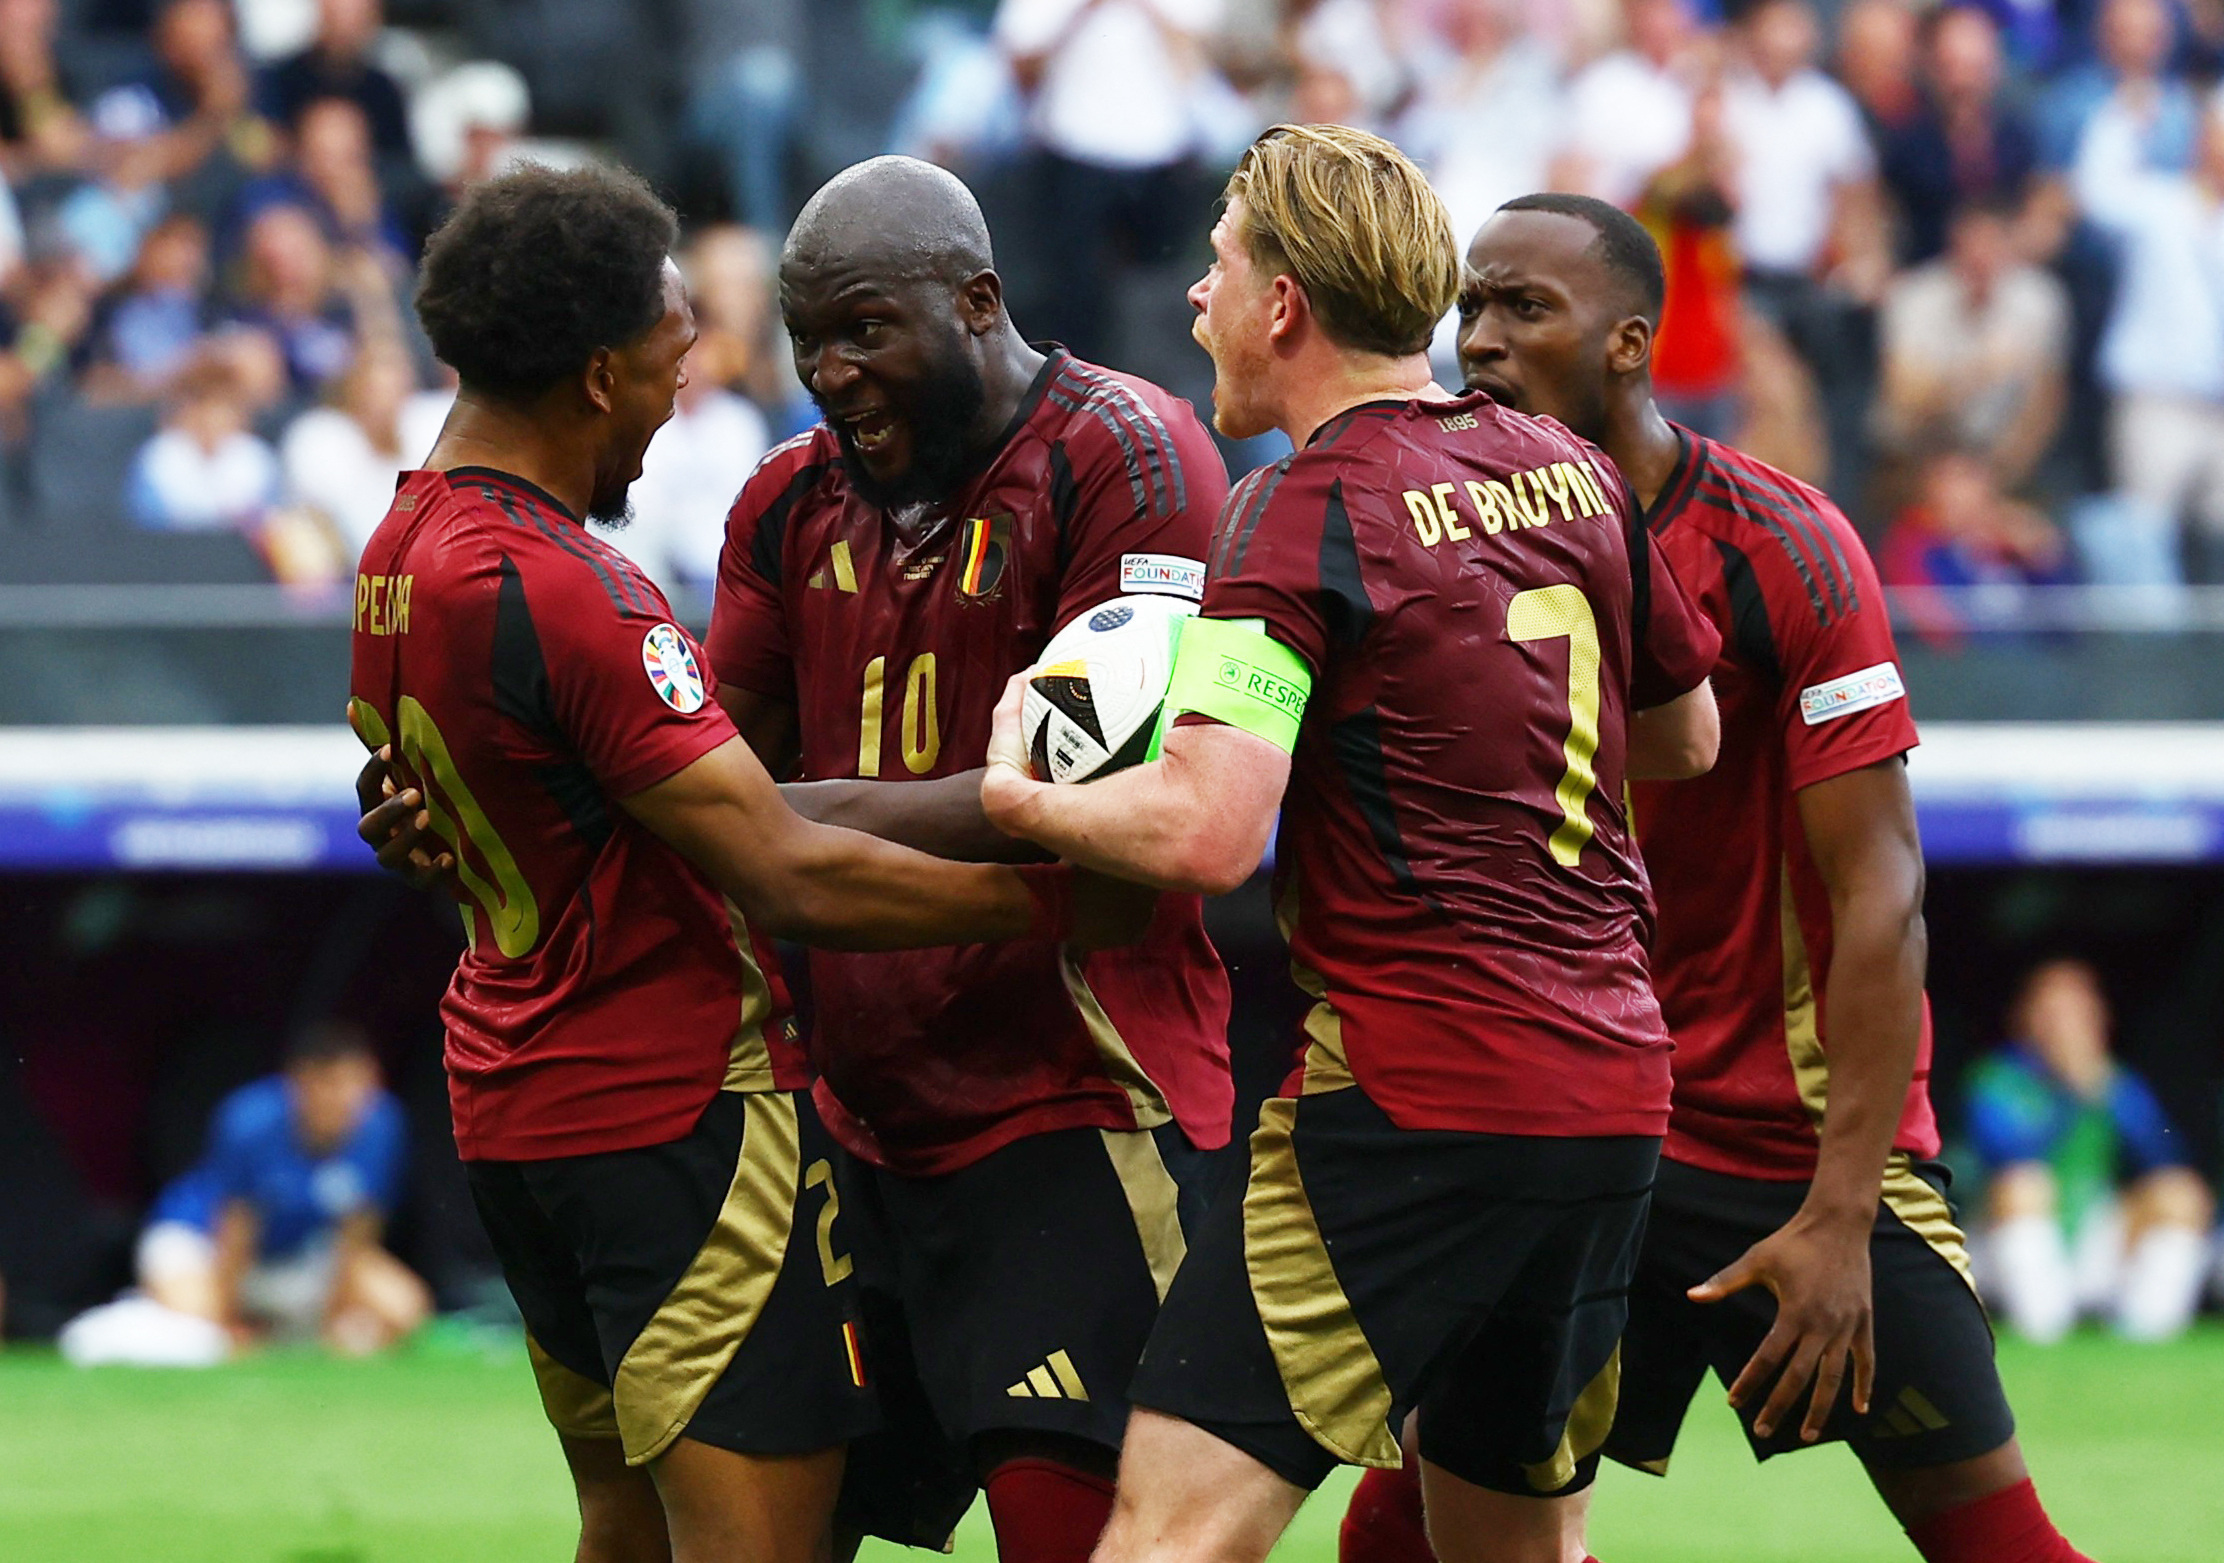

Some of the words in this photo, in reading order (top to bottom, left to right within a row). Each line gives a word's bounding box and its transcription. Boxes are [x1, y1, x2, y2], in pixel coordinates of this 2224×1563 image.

[1435, 412, 1479, 433] 1895
[1124, 558, 1149, 566] UEFA
[1402, 482, 1471, 547] DE
[859, 652, 940, 777] 10
[1507, 584, 1600, 867] 7
[805, 1158, 854, 1287] 2
